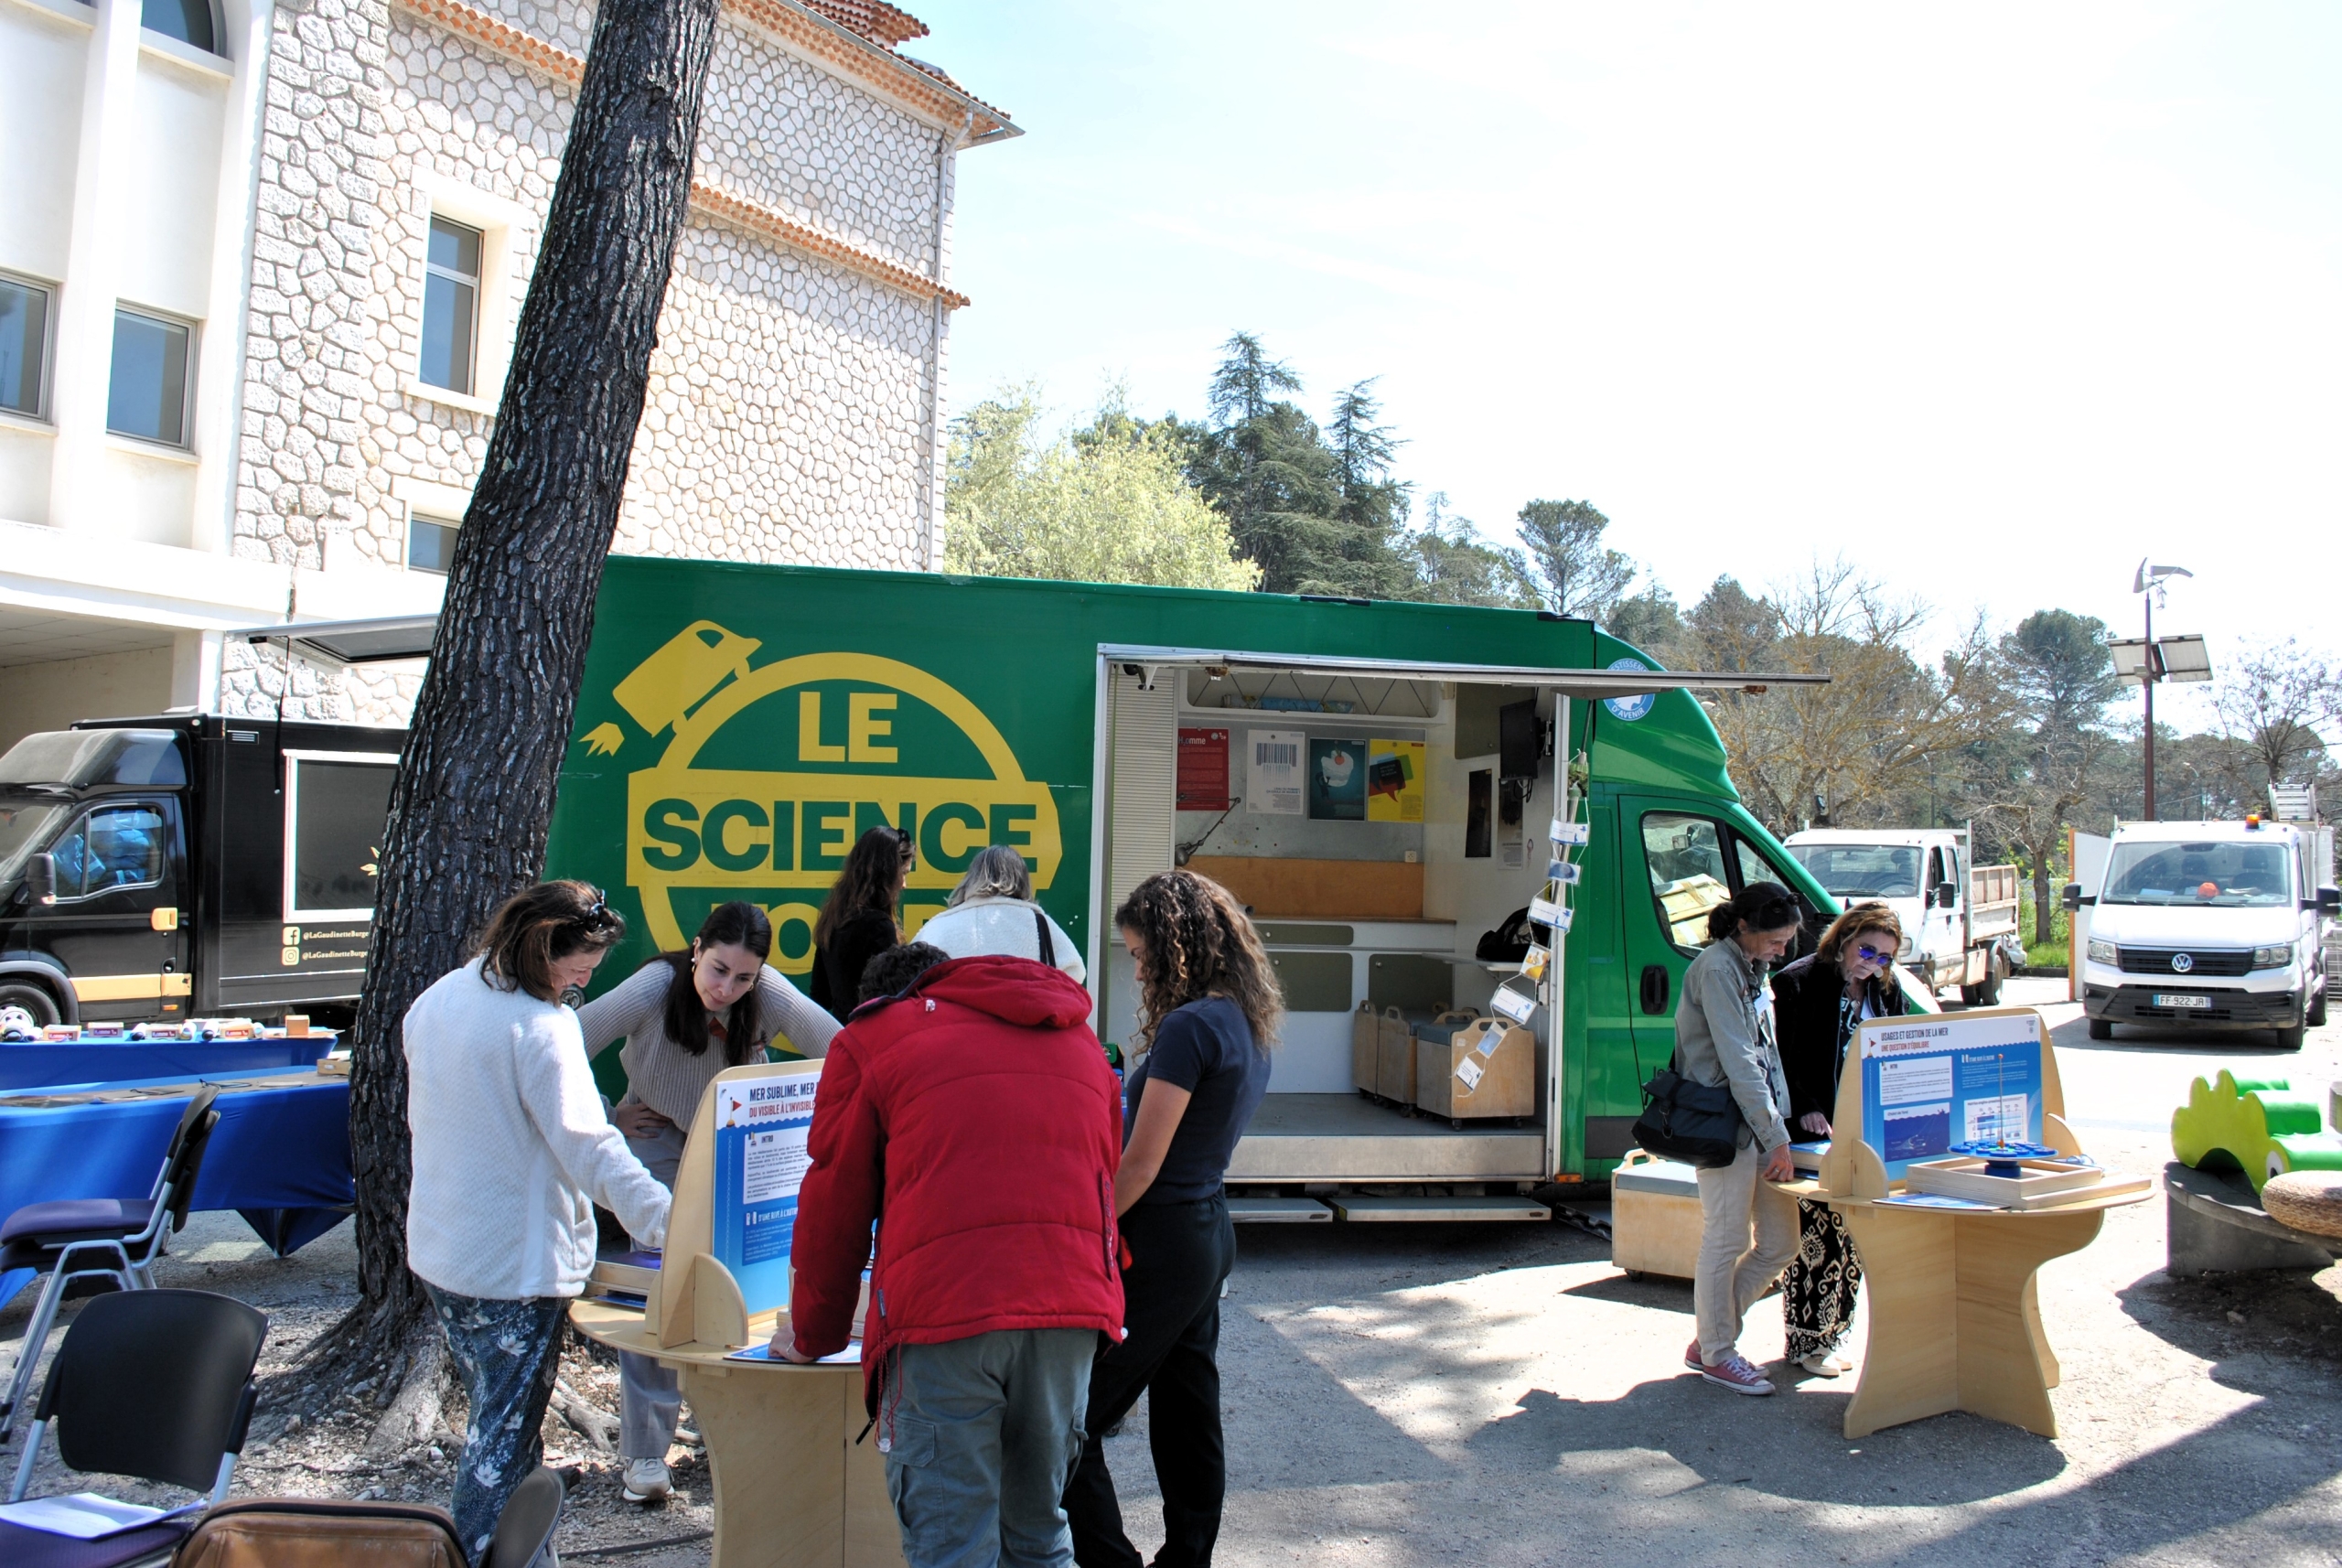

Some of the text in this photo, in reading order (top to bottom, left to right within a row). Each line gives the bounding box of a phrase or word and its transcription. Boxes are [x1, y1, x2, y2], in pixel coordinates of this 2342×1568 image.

[1611, 704, 1645, 719] D'AVENIR
[799, 692, 898, 763] LE
[642, 798, 1037, 874] SCIENCE
[2160, 996, 2204, 1006] FF-922-JA
[1881, 1027, 1949, 1041] USAGES ET GESTION DE LA MER
[1881, 1044, 1889, 1052] UNE
[1889, 1043, 1907, 1052] QUESTION
[750, 1082, 814, 1101] MER SUBLIME, MER
[749, 1100, 815, 1118] DU VISIBLE À L'INVISIBLE
[761, 1134, 774, 1144] INTRO
